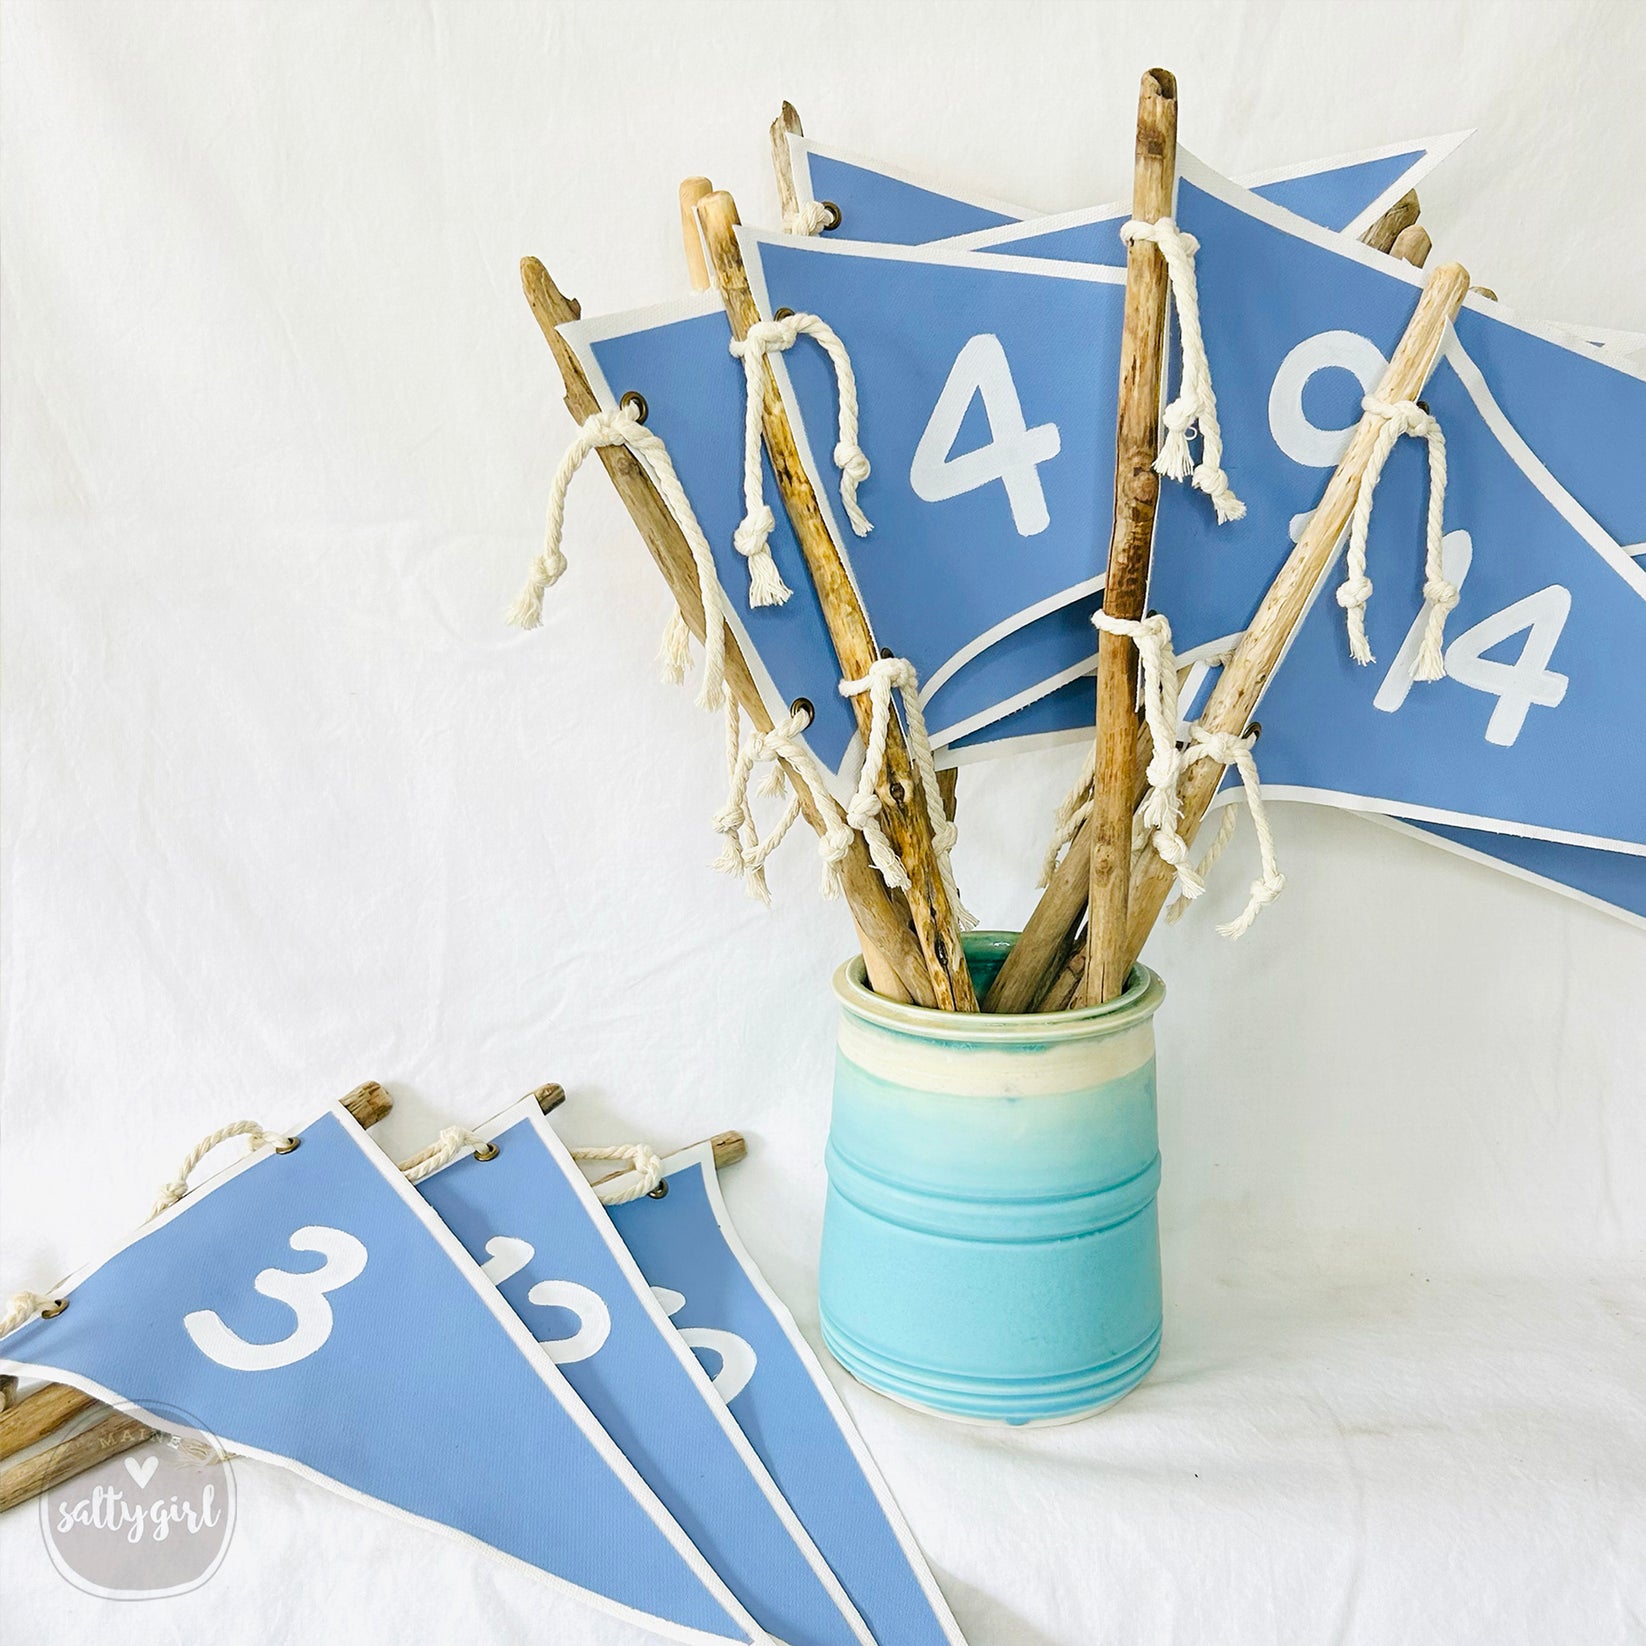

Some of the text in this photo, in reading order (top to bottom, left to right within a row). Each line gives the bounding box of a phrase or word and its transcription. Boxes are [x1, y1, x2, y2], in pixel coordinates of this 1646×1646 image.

[910, 333, 1061, 537] 4
[1373, 529, 1572, 747] 14
[183, 1225, 368, 1371] 3
